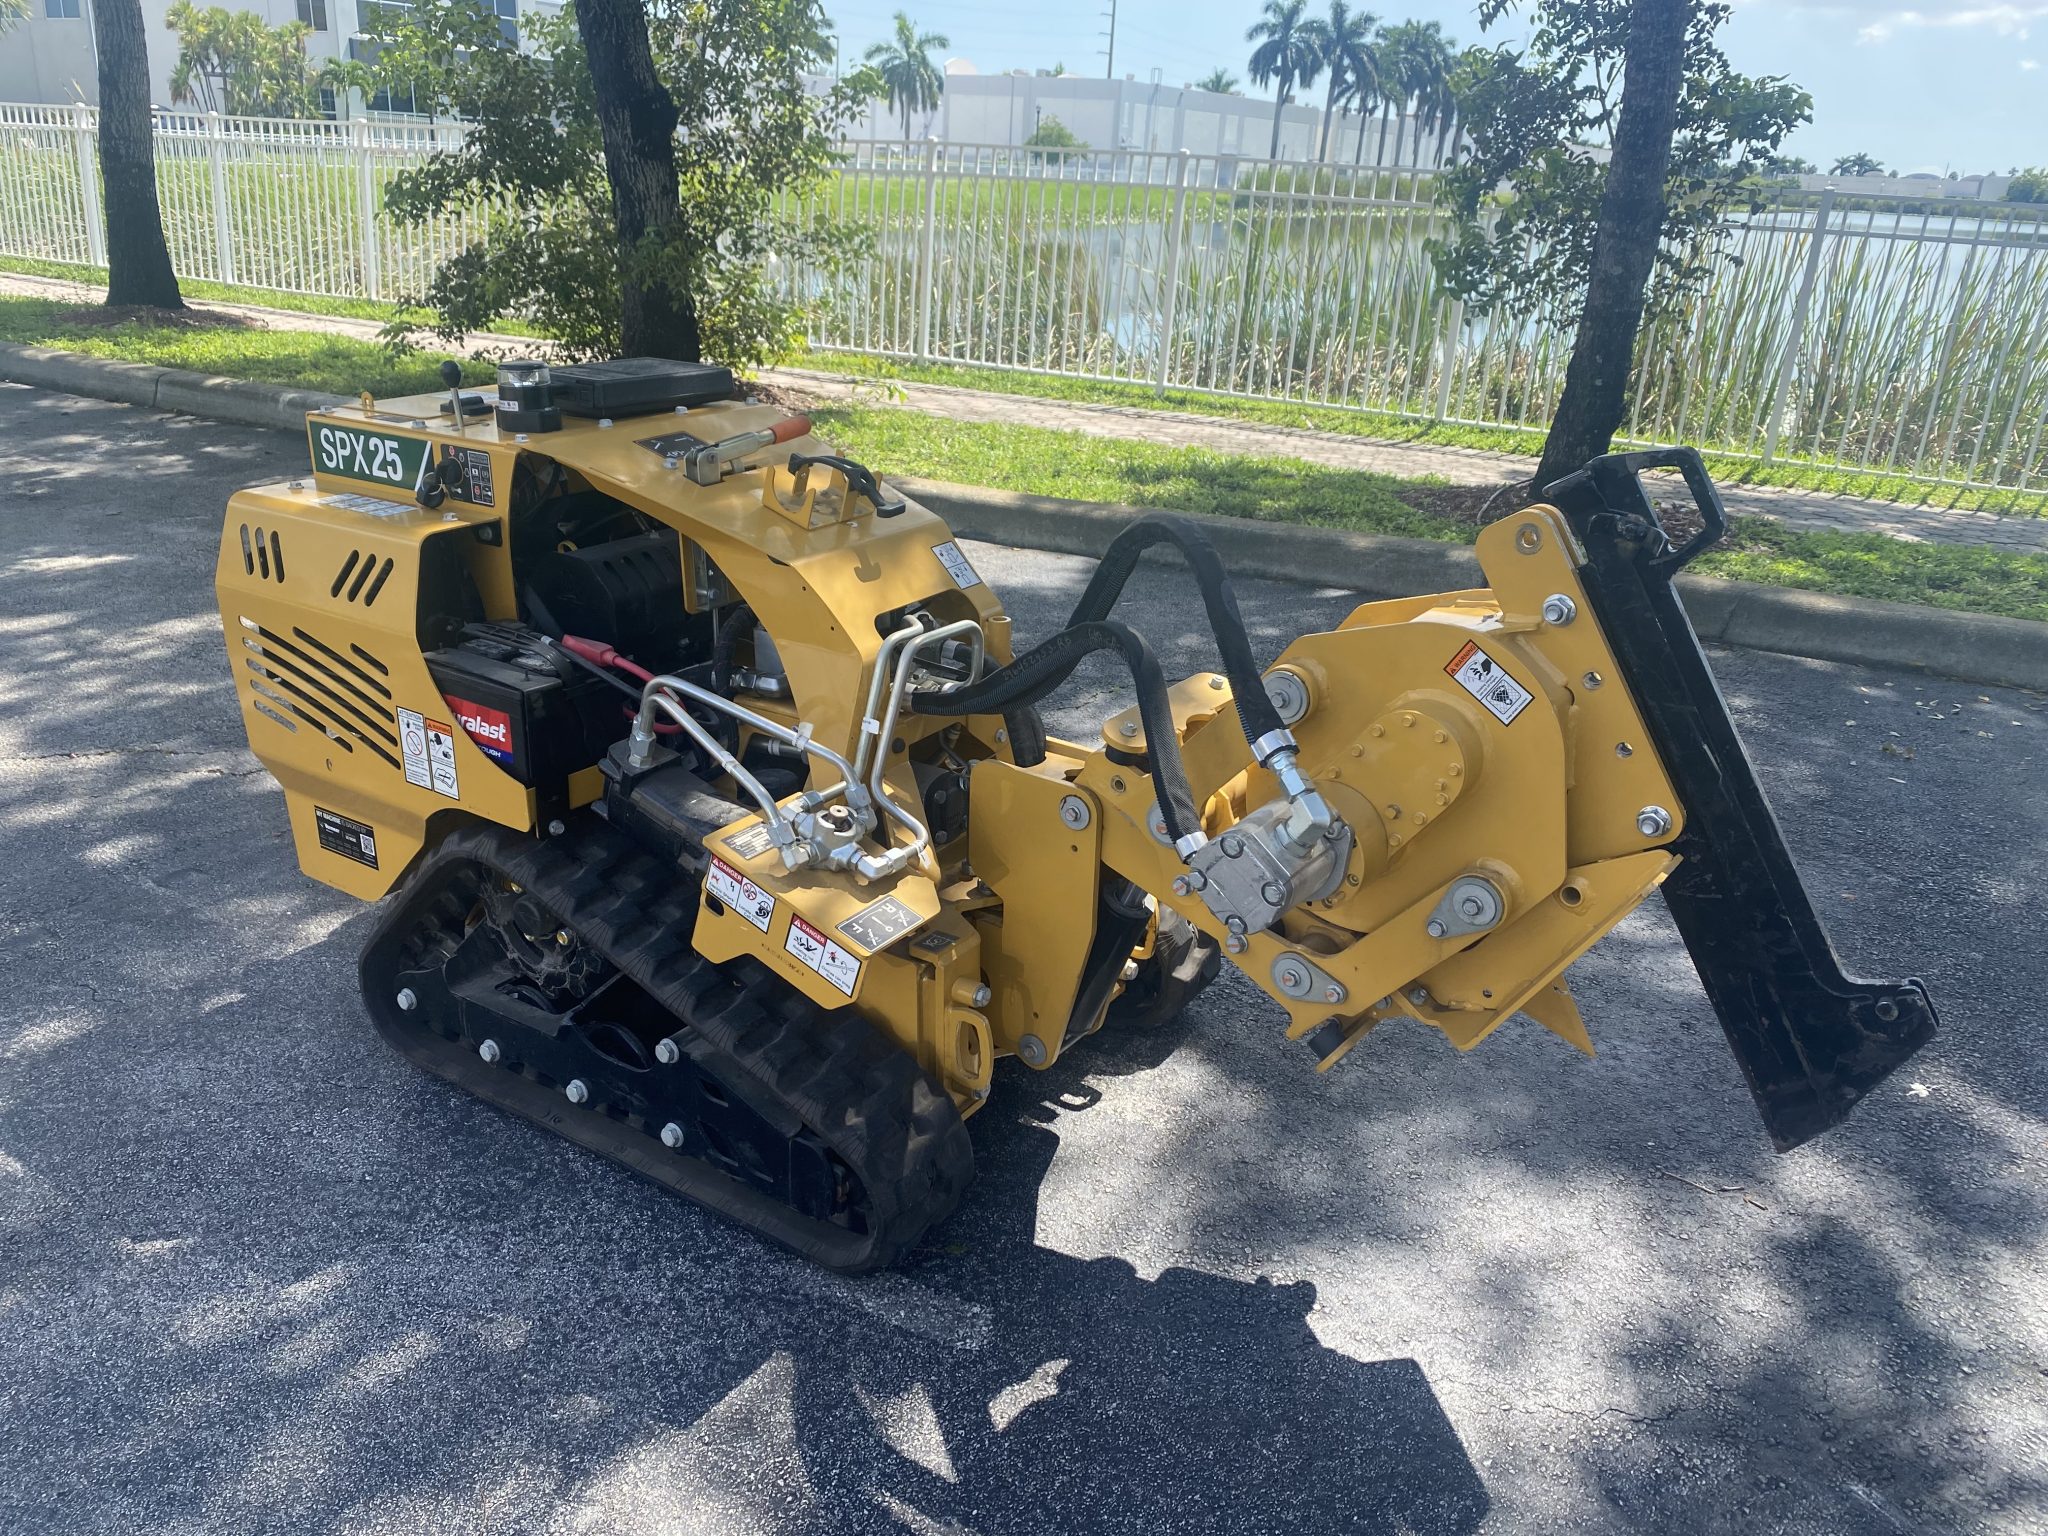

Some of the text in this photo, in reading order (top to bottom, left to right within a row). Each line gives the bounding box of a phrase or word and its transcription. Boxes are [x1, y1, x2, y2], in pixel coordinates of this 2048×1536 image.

[319, 427, 403, 482] SPX25
[1454, 644, 1476, 669] WARNING
[719, 861, 743, 881] DANGER
[880, 902, 897, 913] R
[802, 924, 826, 944] DANGER
